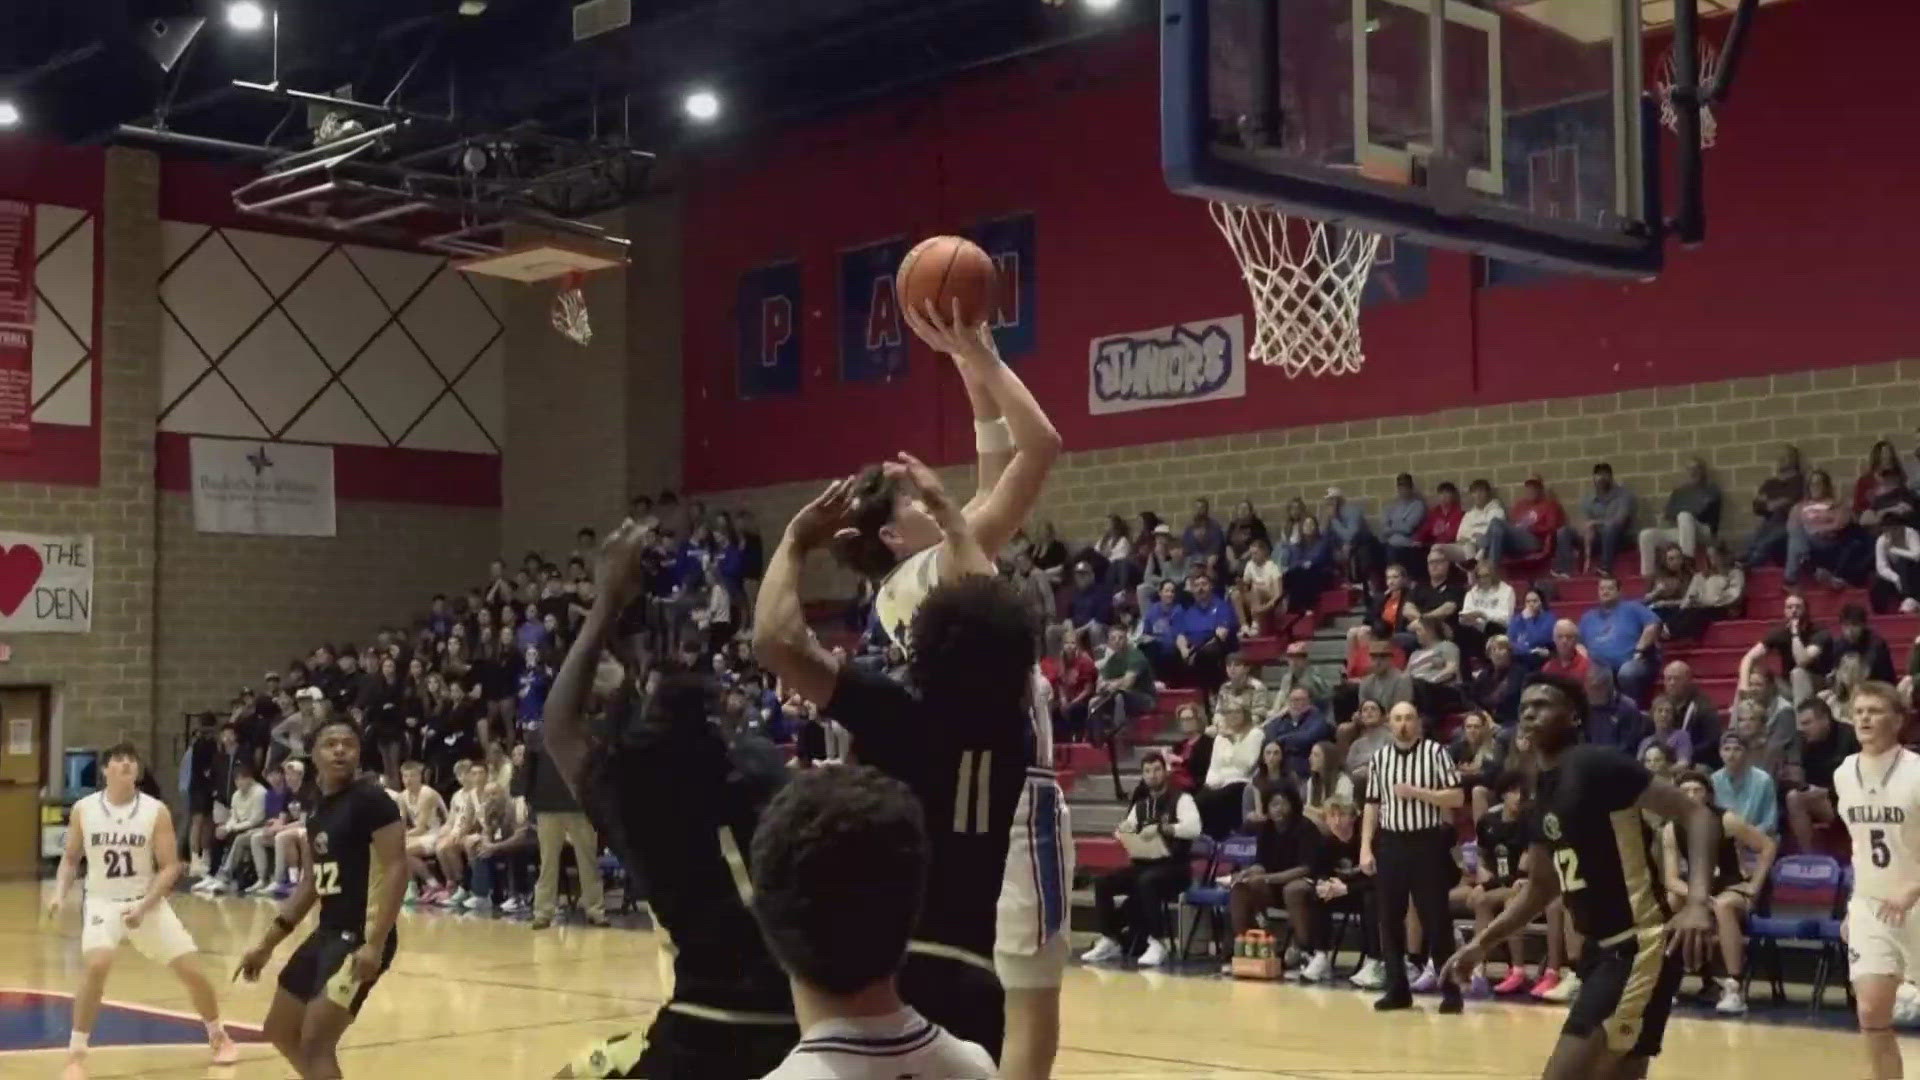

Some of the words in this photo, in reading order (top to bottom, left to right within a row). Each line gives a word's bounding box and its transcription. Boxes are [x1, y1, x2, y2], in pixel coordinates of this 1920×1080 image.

[762, 294, 792, 367] P
[865, 274, 902, 349] A
[1095, 326, 1232, 400] JUNIORS
[42, 543, 87, 568] THE
[35, 587, 90, 620] DEN
[952, 750, 992, 833] 11
[103, 849, 137, 879] 21
[1870, 829, 1891, 869] 5
[313, 862, 342, 895] 22
